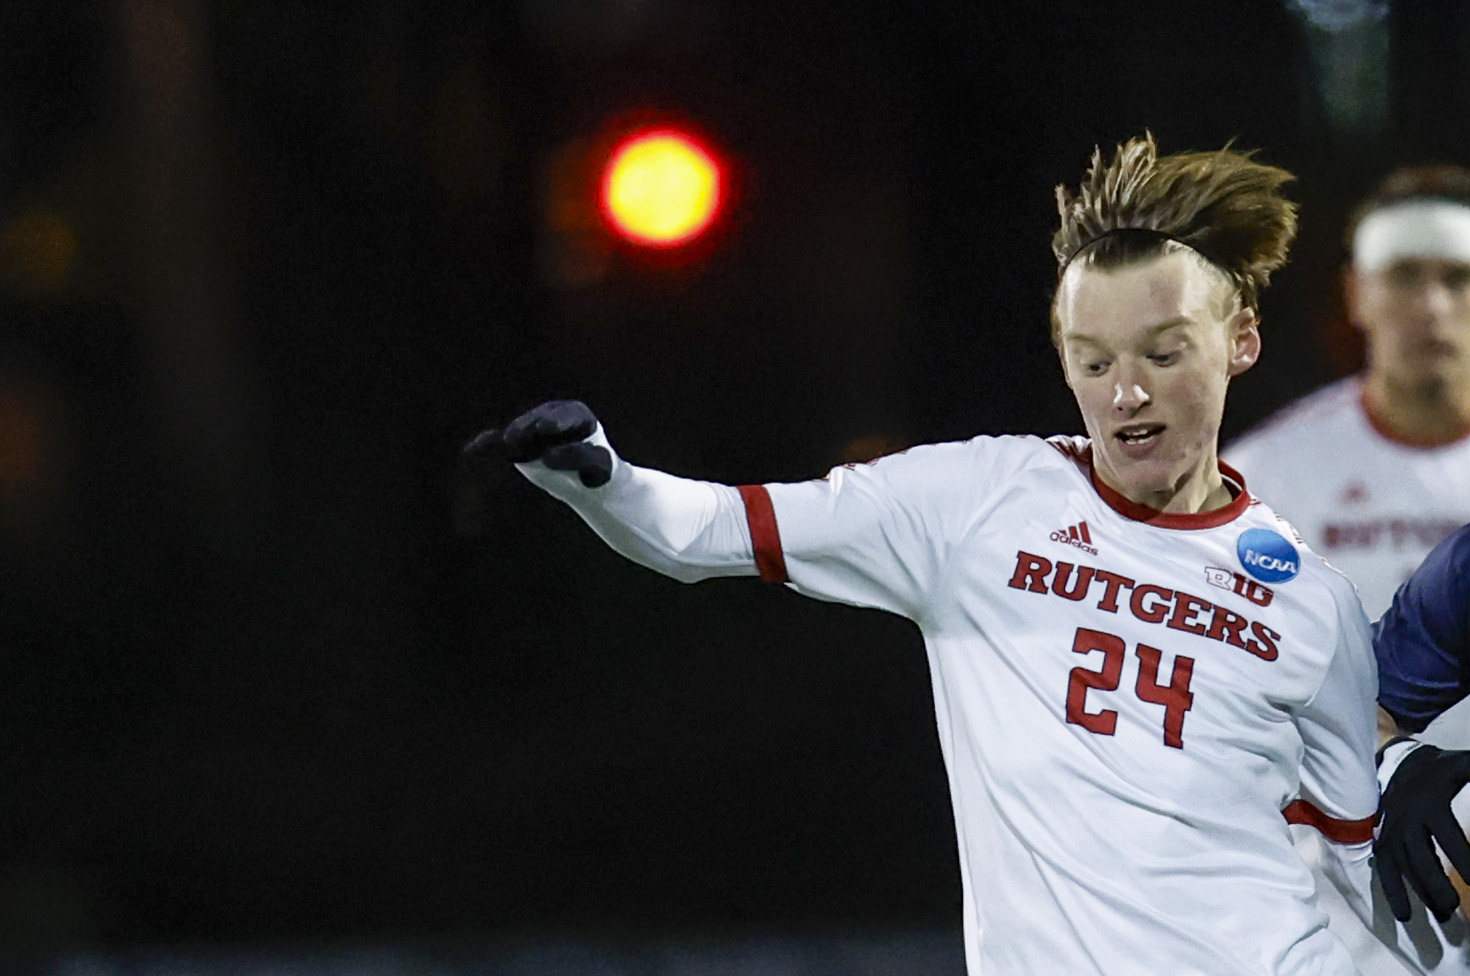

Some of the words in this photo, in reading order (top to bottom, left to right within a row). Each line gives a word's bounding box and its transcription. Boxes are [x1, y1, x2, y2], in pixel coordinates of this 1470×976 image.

[1050, 531, 1098, 556] adidas
[1244, 548, 1297, 575] NCAA
[1008, 550, 1281, 662] RUTGERS
[1065, 627, 1195, 750] 24
